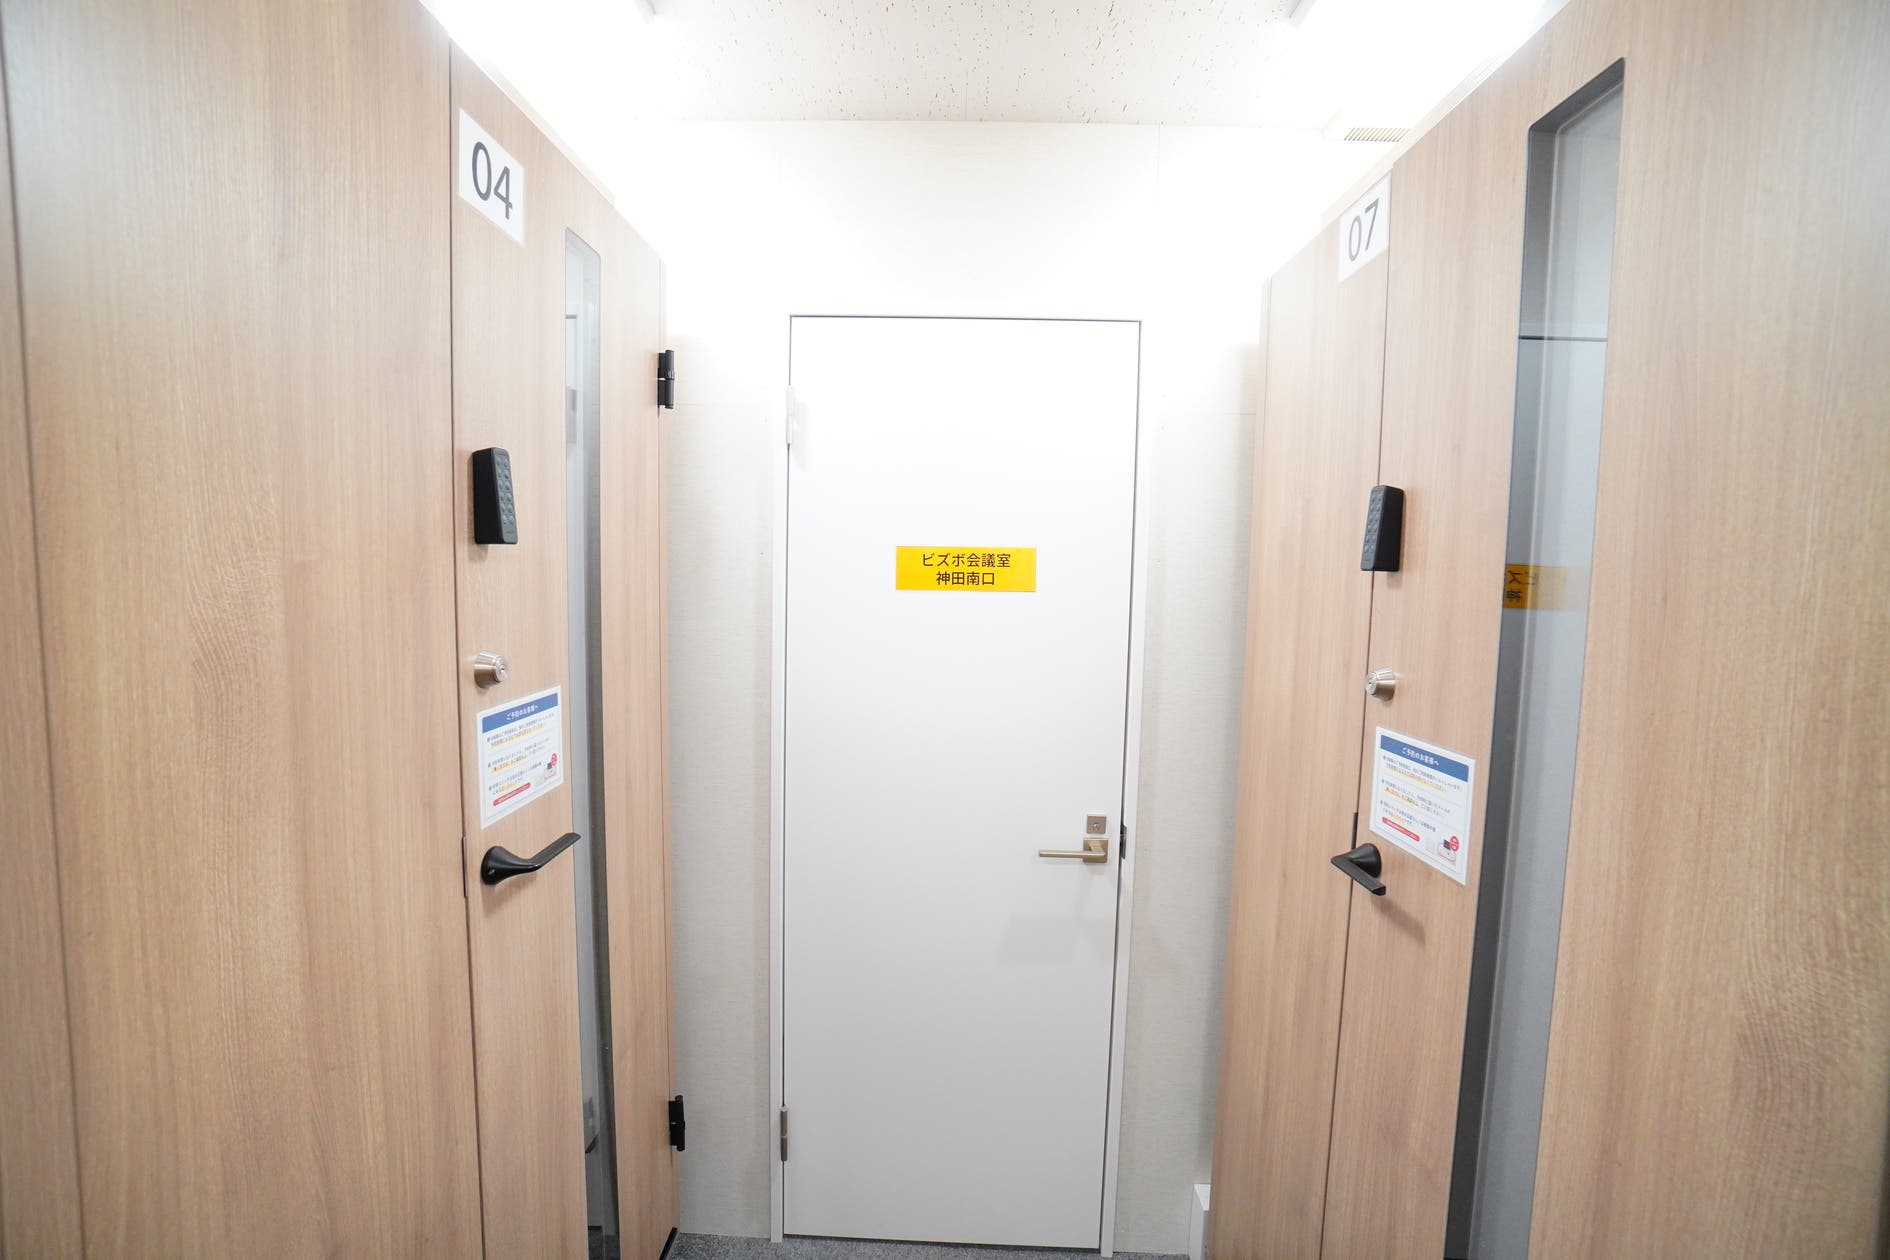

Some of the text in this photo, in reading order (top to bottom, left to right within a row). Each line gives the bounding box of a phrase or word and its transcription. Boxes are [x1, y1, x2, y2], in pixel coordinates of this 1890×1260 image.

[472, 141, 513, 220] 04
[1349, 198, 1379, 262] 07
[936, 571, 995, 586] 神田南口
[1401, 747, 1440, 766] ご予約のお客様へ
